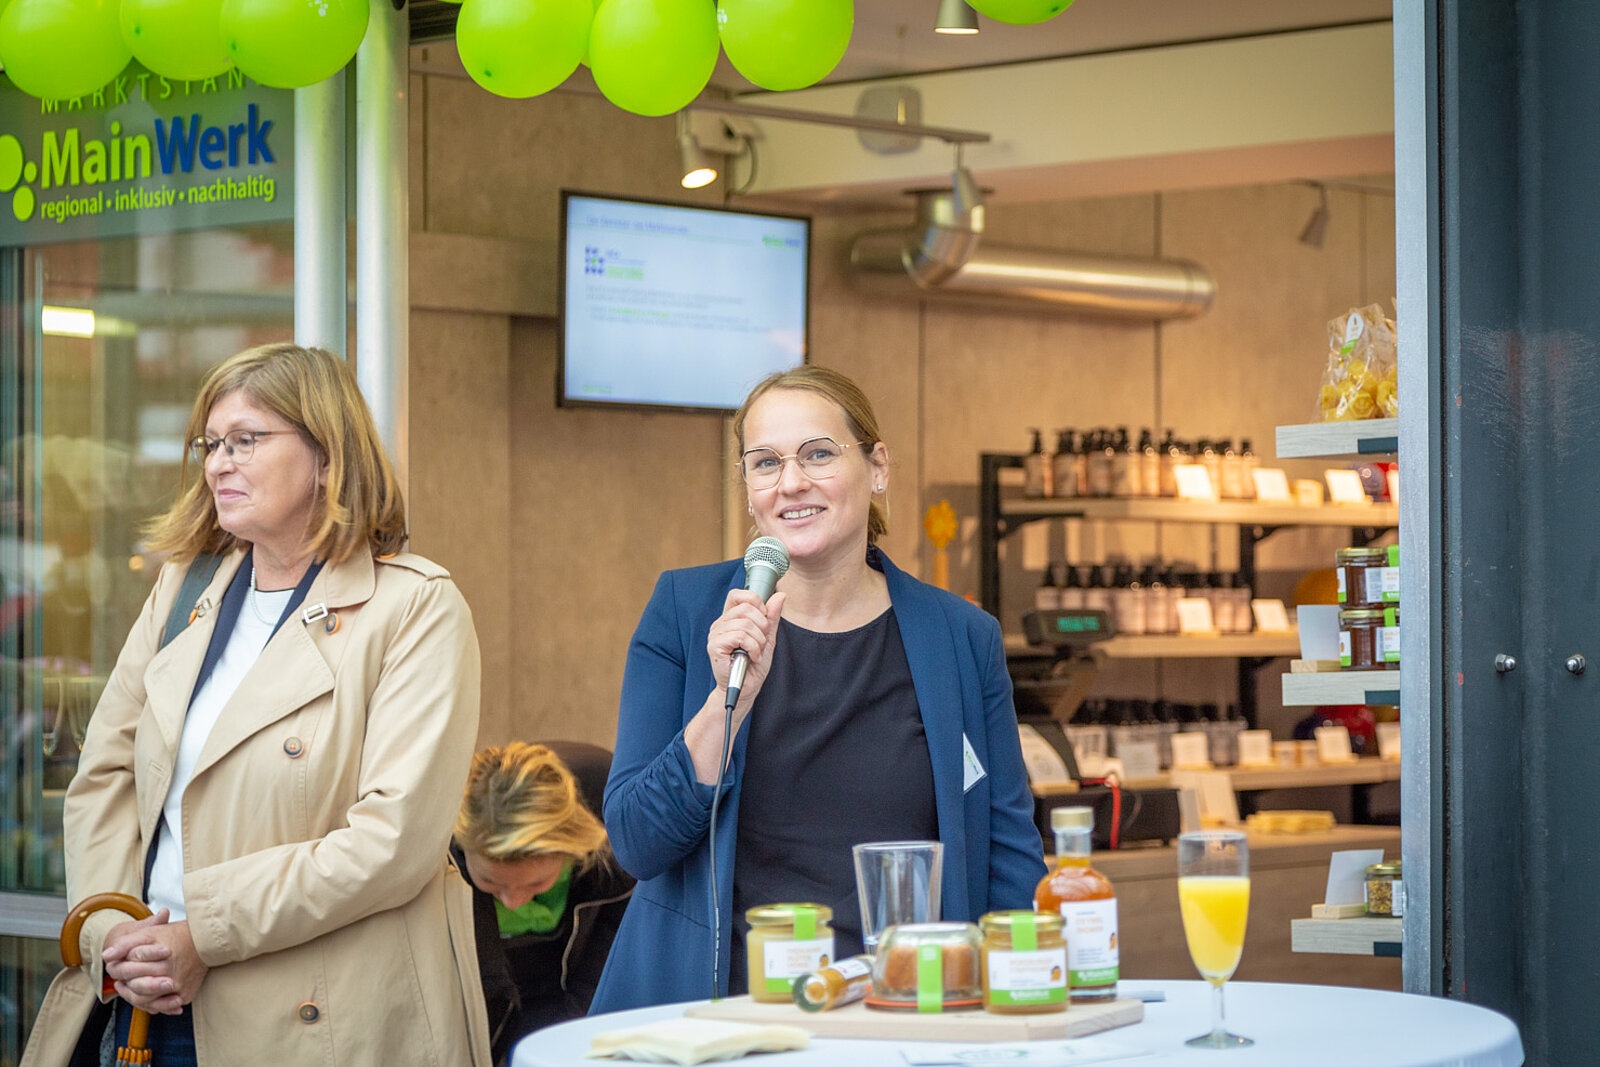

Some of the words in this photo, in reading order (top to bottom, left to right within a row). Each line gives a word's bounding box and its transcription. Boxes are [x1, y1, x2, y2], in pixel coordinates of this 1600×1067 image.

[41, 103, 274, 189] MainWerk
[41, 191, 103, 223] regional
[115, 186, 175, 212] inklusiv
[188, 175, 274, 202] nachhaltig
